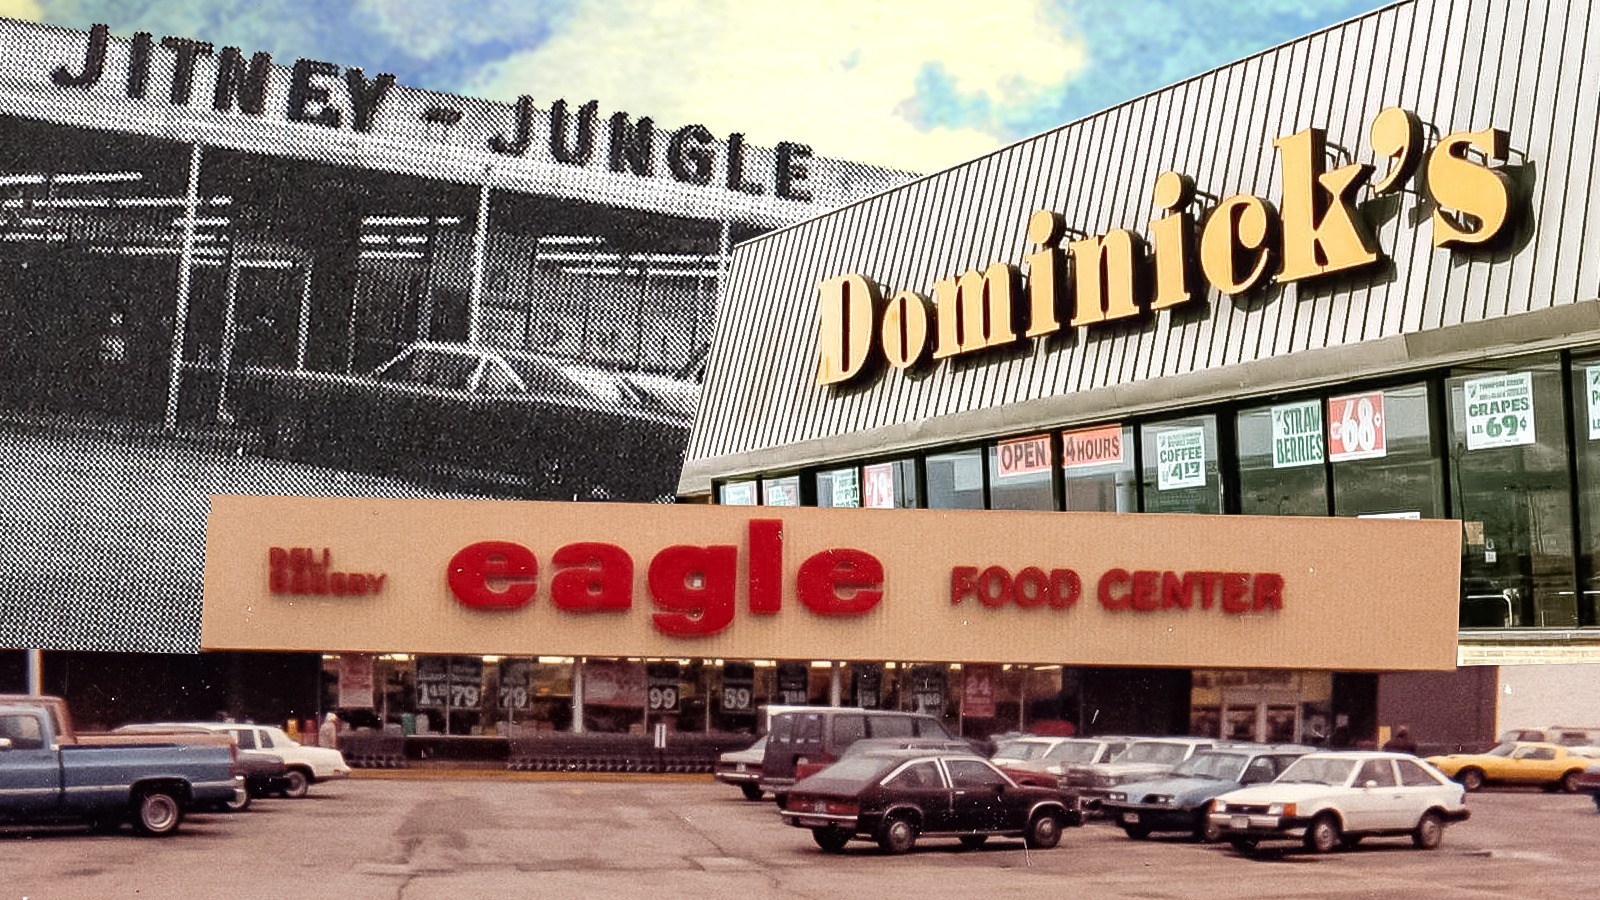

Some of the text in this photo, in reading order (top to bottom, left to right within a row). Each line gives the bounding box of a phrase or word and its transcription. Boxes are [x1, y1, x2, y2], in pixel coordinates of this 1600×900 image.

[51, 24, 397, 132] JITNEY
[488, 95, 814, 202] JUNGLE
[818, 106, 1511, 385] Dominick's
[1283, 404, 1321, 436] STRAW
[1469, 397, 1529, 417] GRAPES
[1001, 440, 1047, 471] OPEN
[1077, 435, 1120, 461] HOURS
[1160, 446, 1203, 464] COFFEE
[1276, 433, 1323, 465] BERRIES
[447, 518, 885, 638] eagle
[951, 565, 1285, 615] FOOD CENTER
[451, 684, 479, 707] 79
[649, 687, 676, 709] 99
